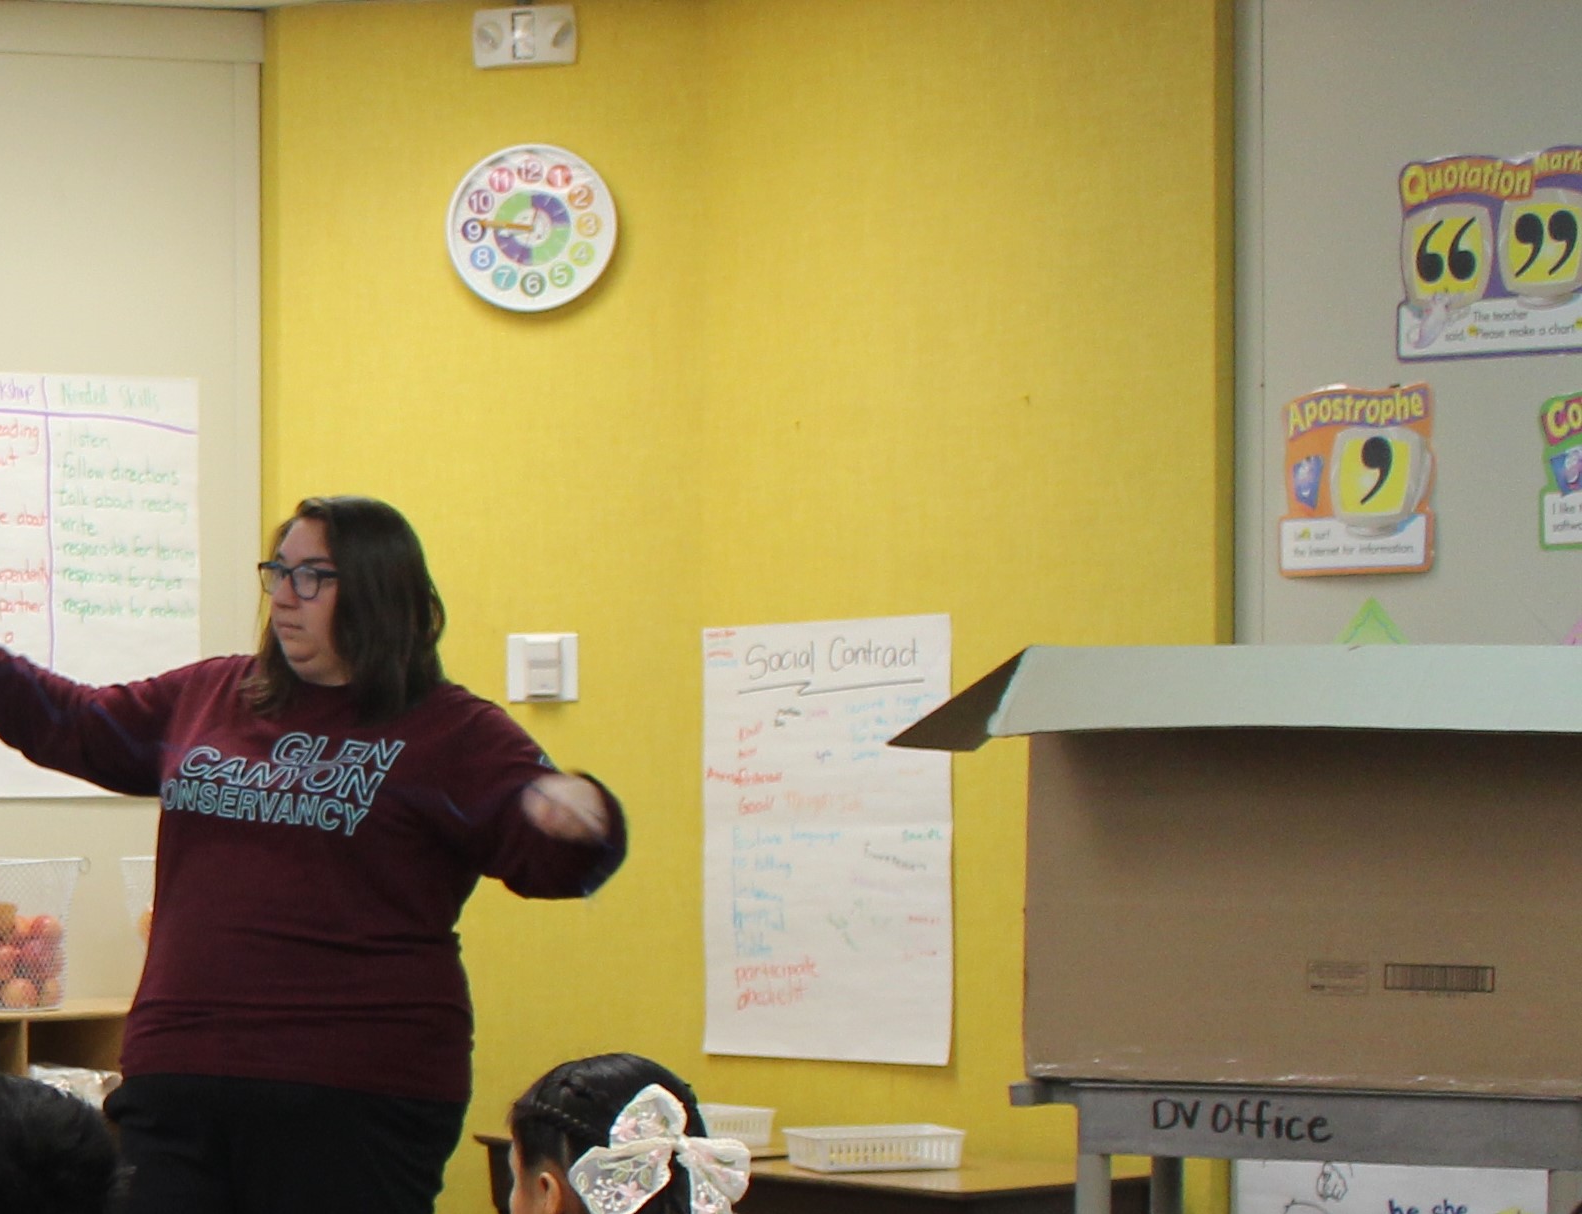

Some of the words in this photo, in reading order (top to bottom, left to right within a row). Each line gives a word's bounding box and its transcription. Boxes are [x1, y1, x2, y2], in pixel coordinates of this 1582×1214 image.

[1402, 164, 1534, 208] Quotation
[1536, 150, 1582, 173] Mark
[1286, 390, 1425, 437] Apostrophe
[745, 640, 816, 681] Social
[828, 636, 919, 674] Contract
[272, 731, 406, 772] GLEN
[179, 746, 390, 807] CANYON
[160, 778, 369, 836] ONSERVANCY
[1152, 1099, 1203, 1131] DV
[1210, 1098, 1336, 1145] Office
